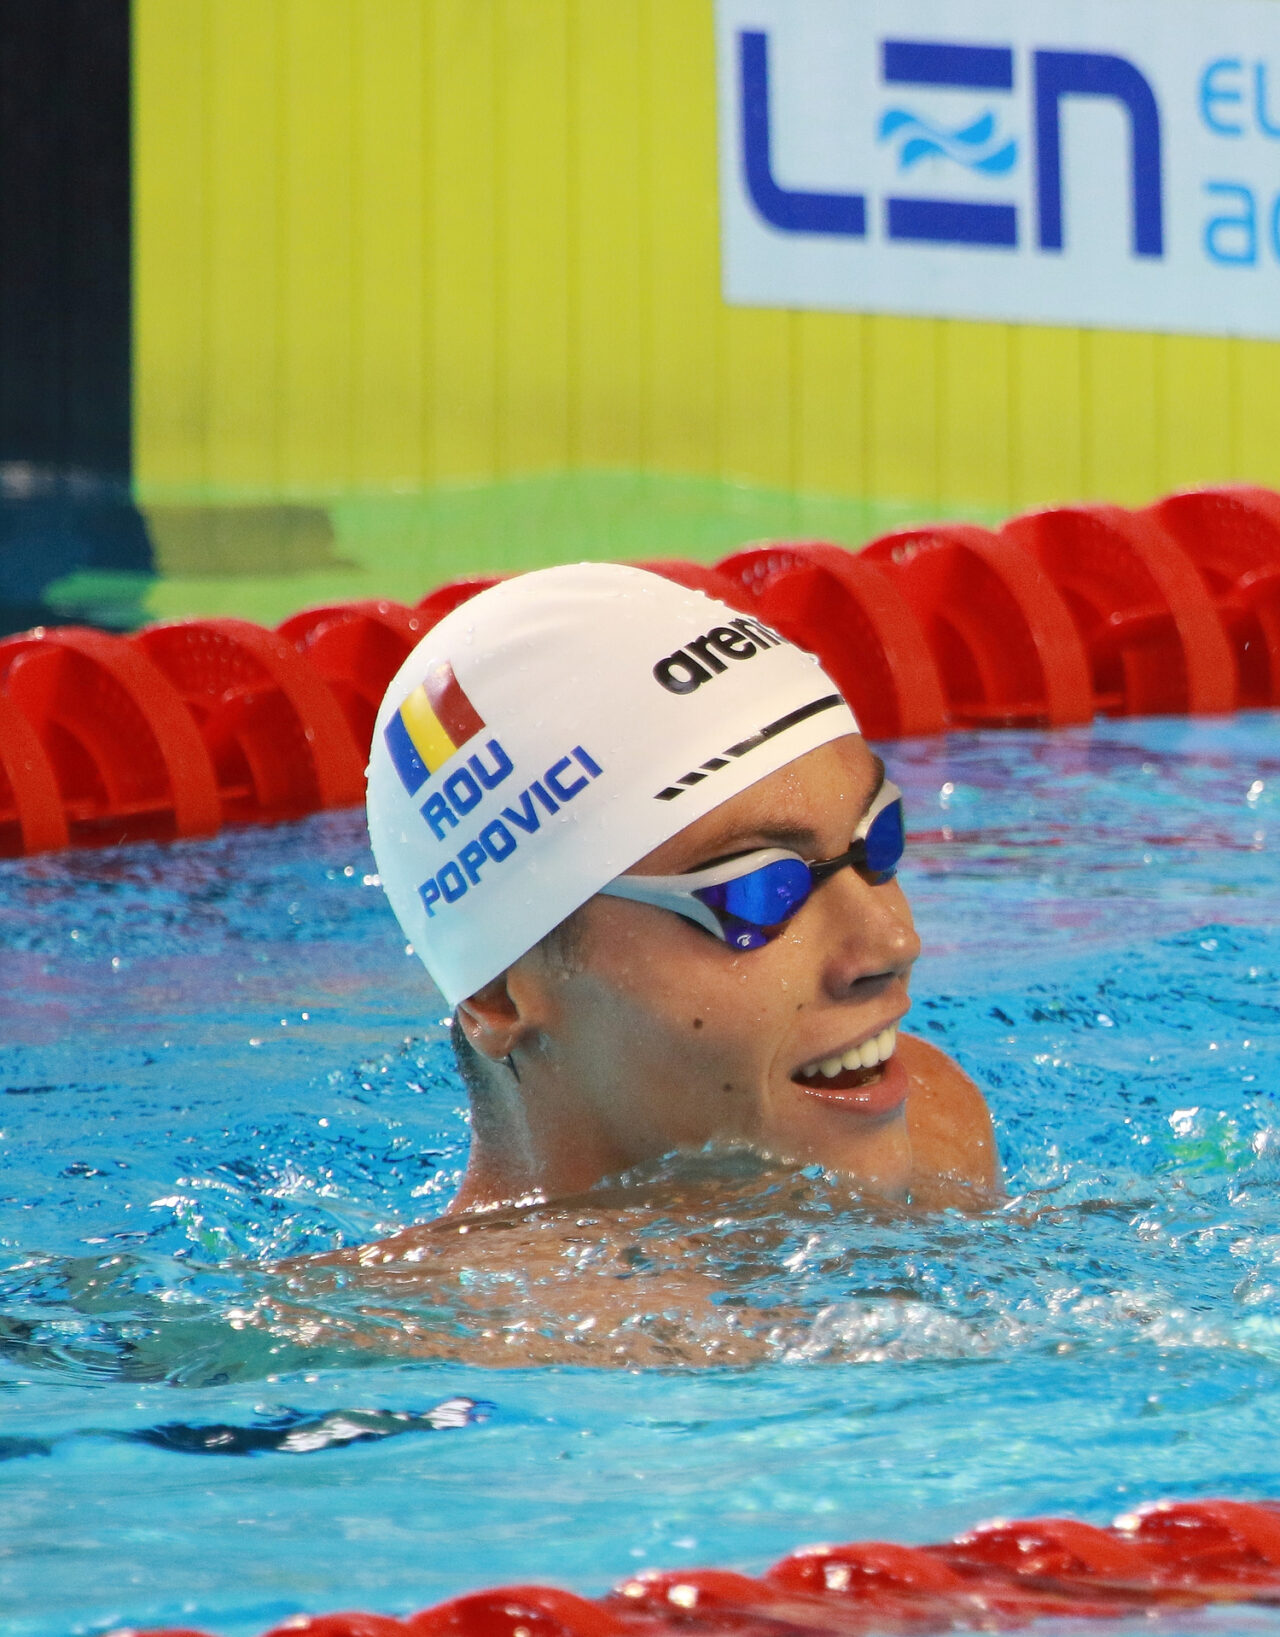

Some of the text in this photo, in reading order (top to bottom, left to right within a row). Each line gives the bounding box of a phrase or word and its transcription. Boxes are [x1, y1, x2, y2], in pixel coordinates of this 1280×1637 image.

[652, 617, 790, 695] aren
[416, 744, 605, 918] POPOVICI
[418, 738, 514, 842] ROU
